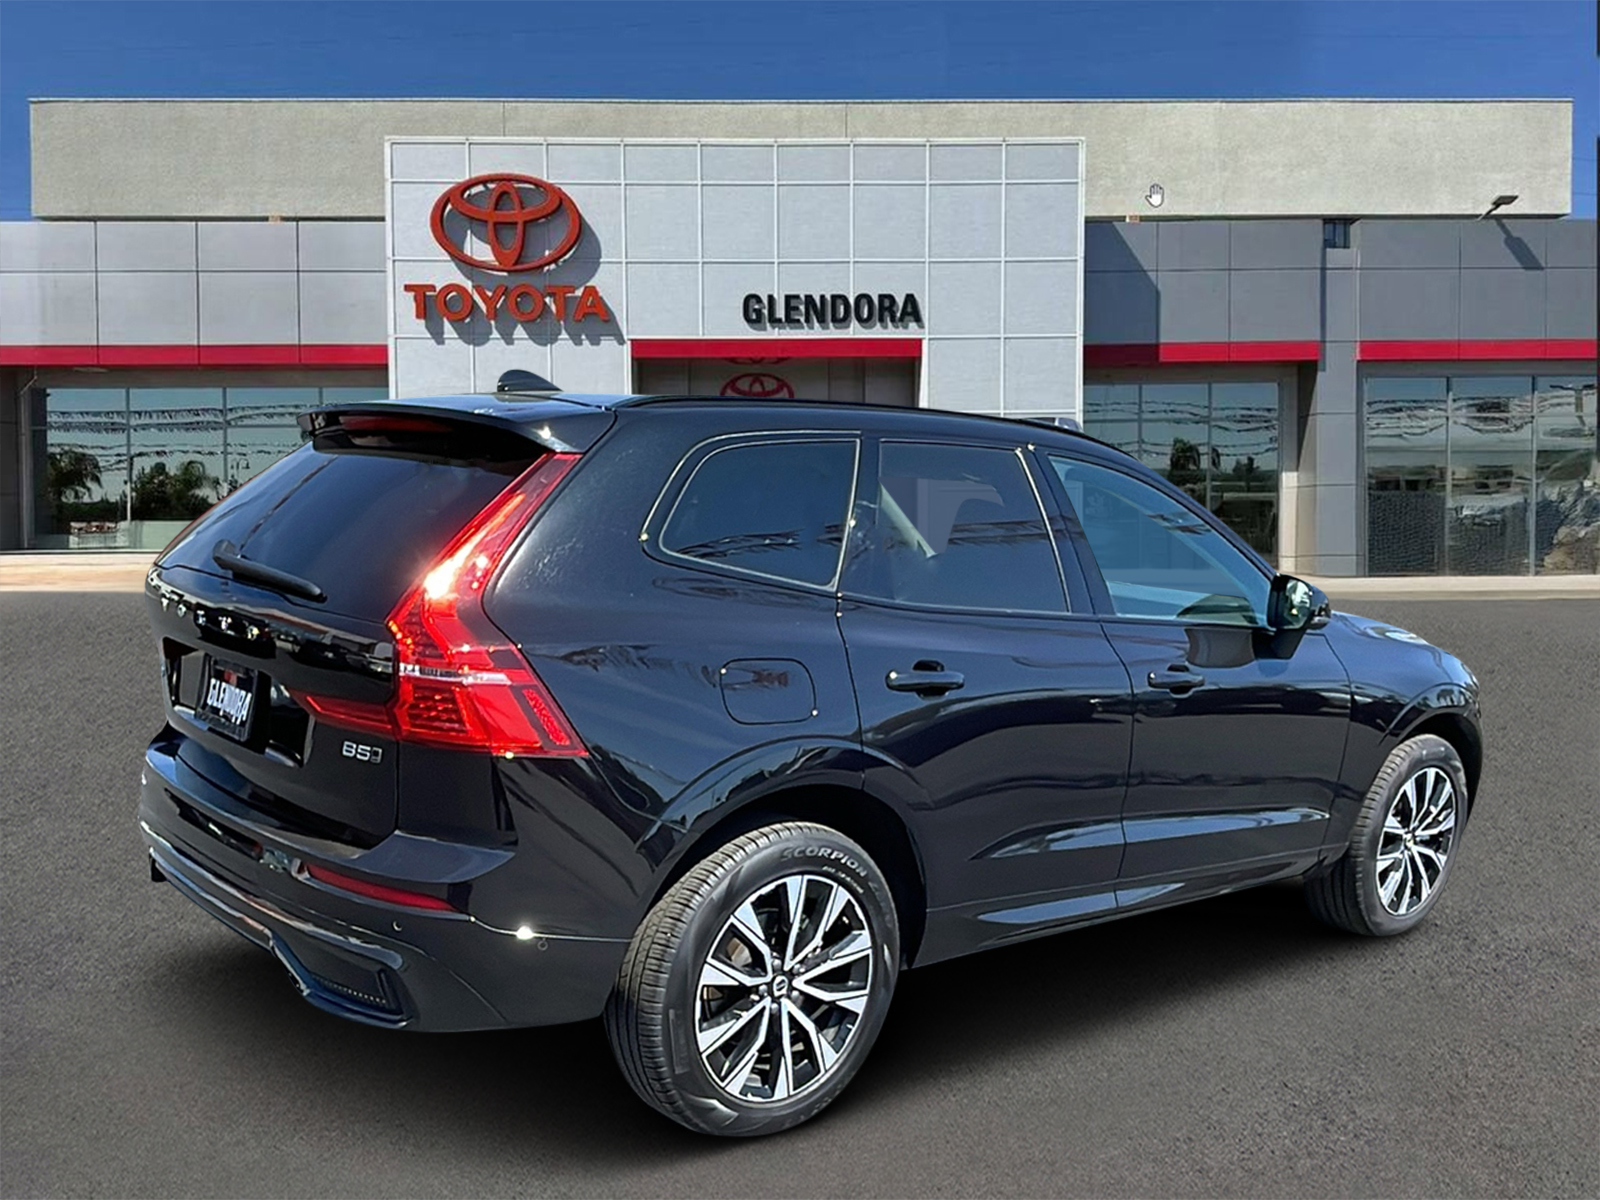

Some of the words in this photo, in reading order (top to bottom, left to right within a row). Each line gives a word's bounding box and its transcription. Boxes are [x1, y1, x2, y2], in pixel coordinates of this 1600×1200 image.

[404, 283, 609, 322] TOYOTA
[743, 293, 922, 324] GLENDORA
[782, 846, 868, 877] SCORPION
